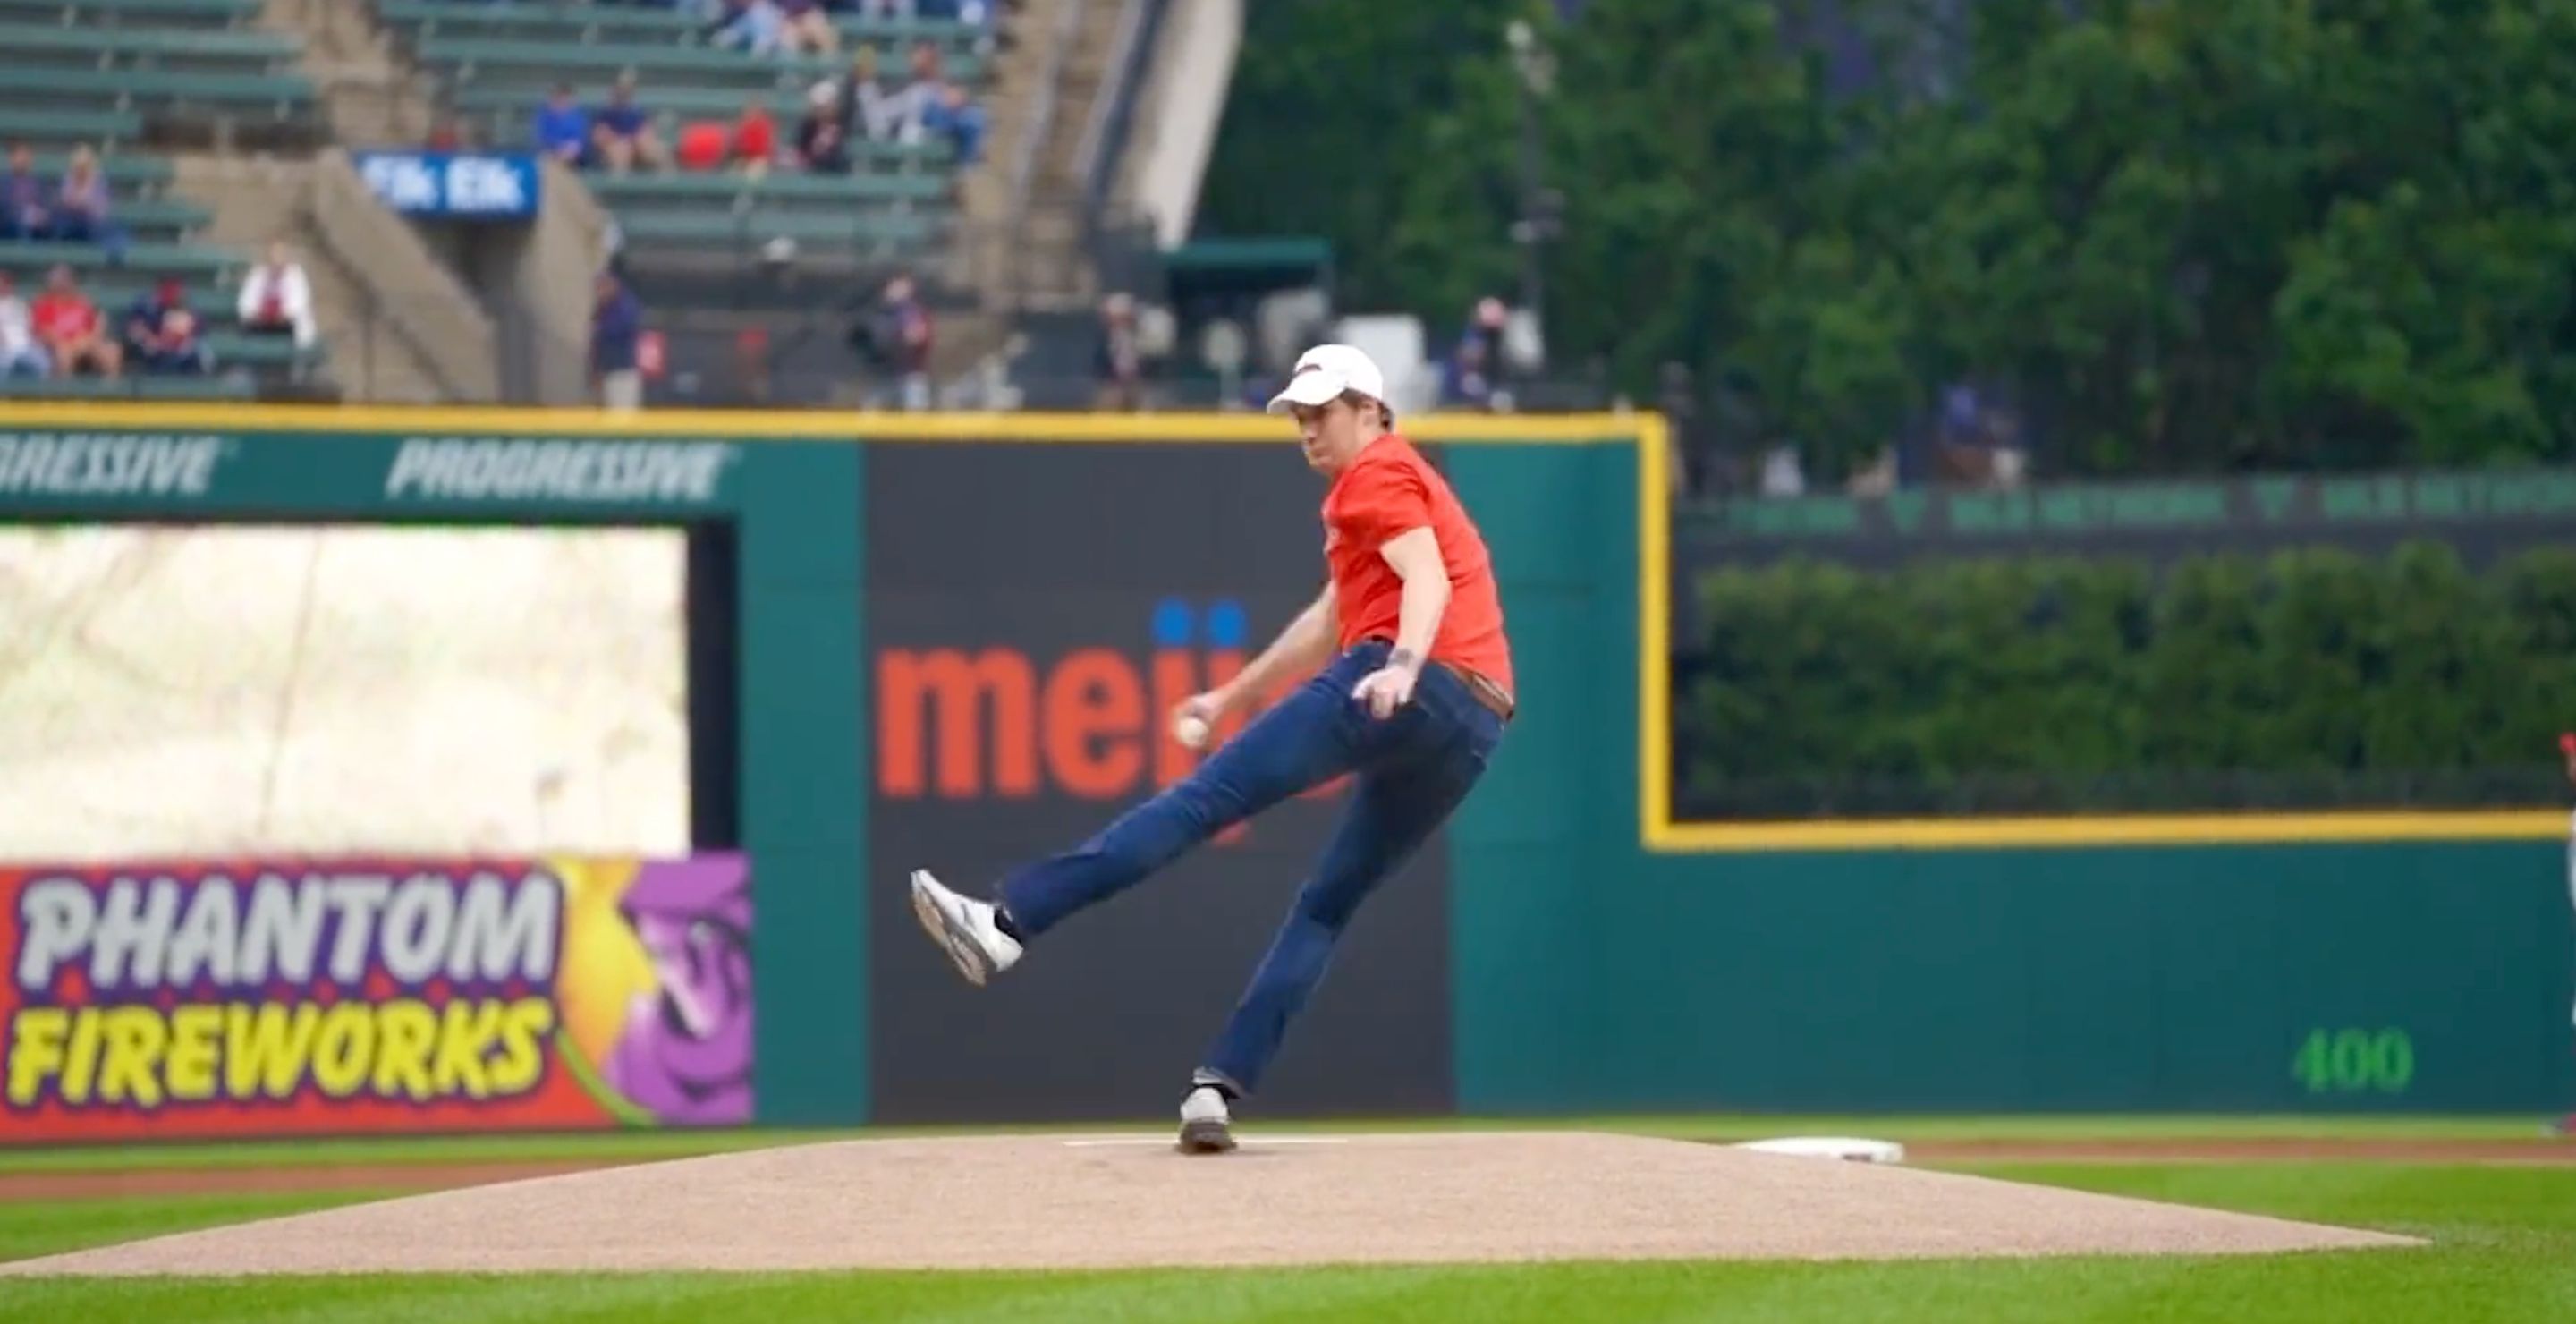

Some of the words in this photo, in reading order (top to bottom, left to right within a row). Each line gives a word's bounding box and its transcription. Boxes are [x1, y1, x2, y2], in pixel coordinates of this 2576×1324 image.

[446, 156, 526, 211] Elk
[385, 437, 723, 500] PROGRESSIVE
[877, 598, 1358, 846] meij
[16, 871, 560, 988] PHANTOM
[7, 997, 554, 1107] FIREWORKS
[2292, 1028, 2413, 1092] 400
